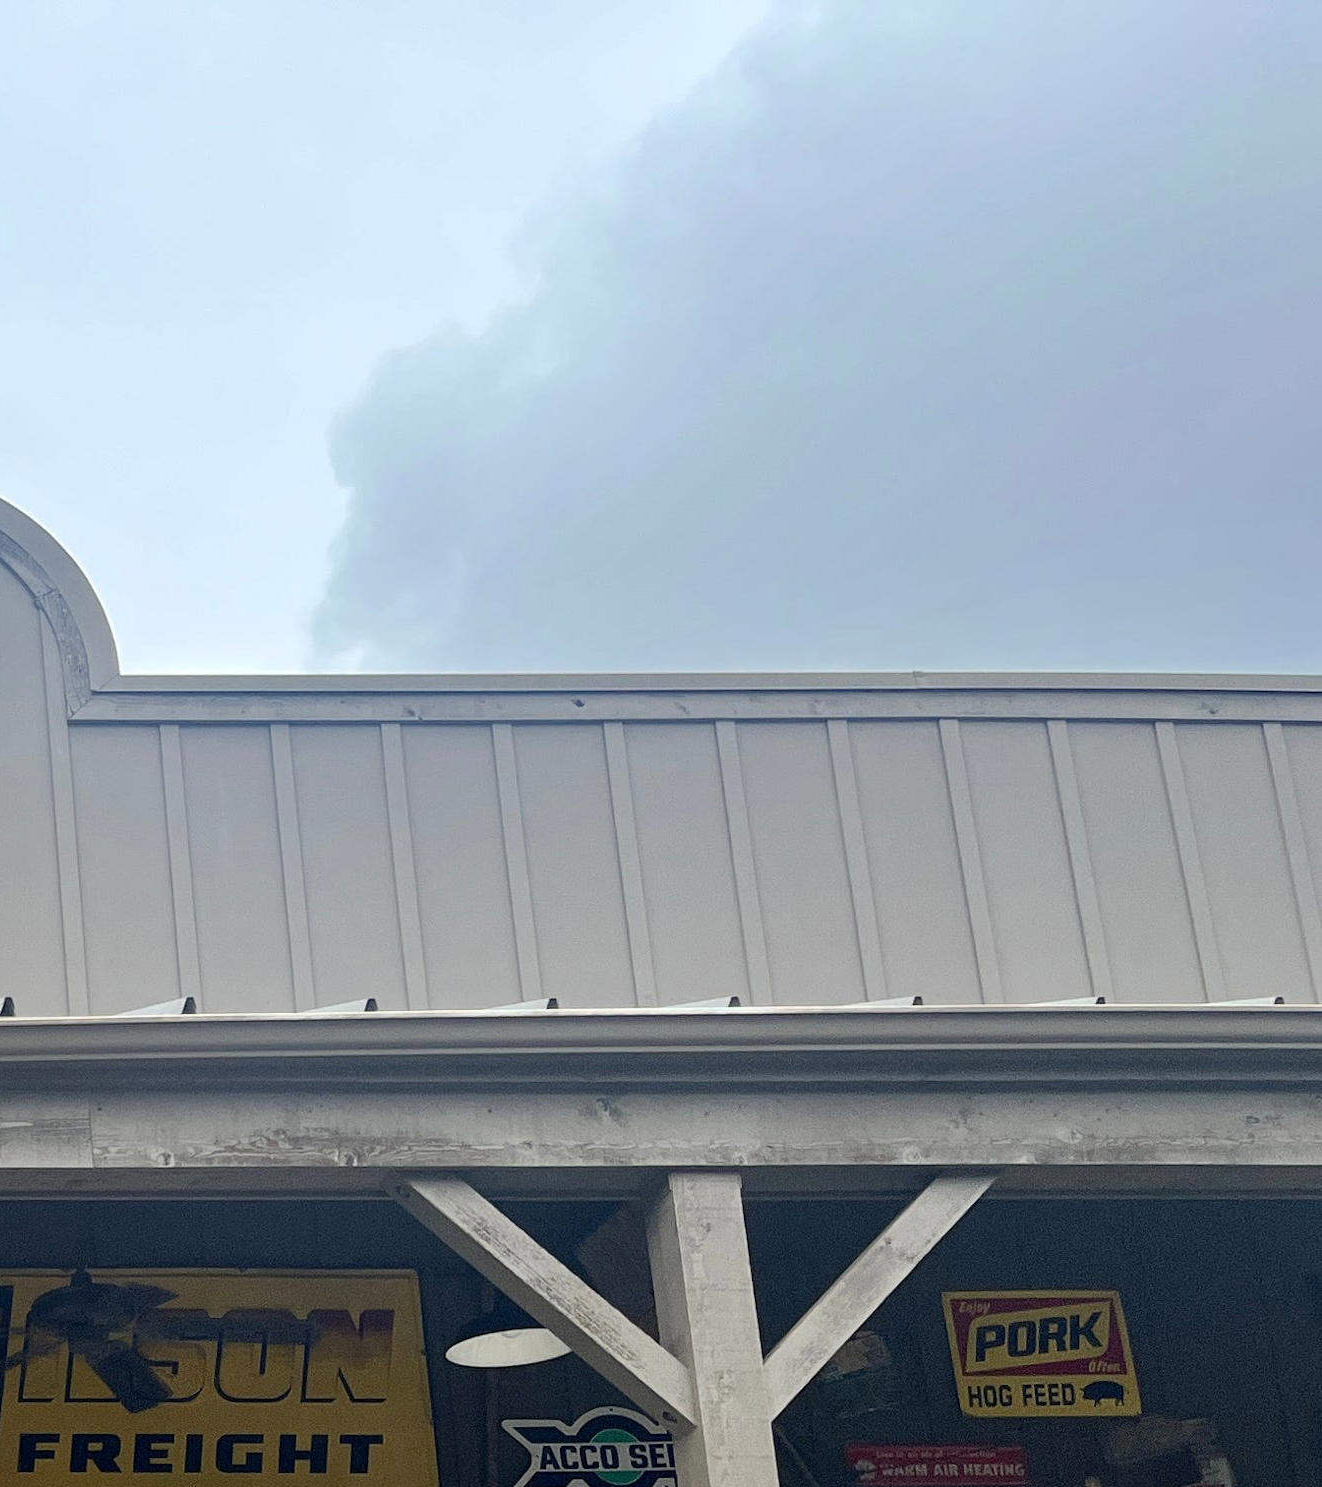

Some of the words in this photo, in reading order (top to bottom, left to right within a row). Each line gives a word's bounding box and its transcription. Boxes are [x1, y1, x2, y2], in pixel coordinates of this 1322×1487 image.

[959, 1300, 991, 1317] Enjoy
[975, 1311, 1103, 1362] PORK
[967, 1384, 1013, 1408] HOG
[1021, 1383, 1075, 1407] FEED
[17, 1433, 384, 1474] FREIGHT
[540, 1445, 619, 1470] ACCO
[881, 1463, 928, 1477] WARM
[932, 1463, 959, 1477] AIR
[963, 1463, 1026, 1478] HEATING
